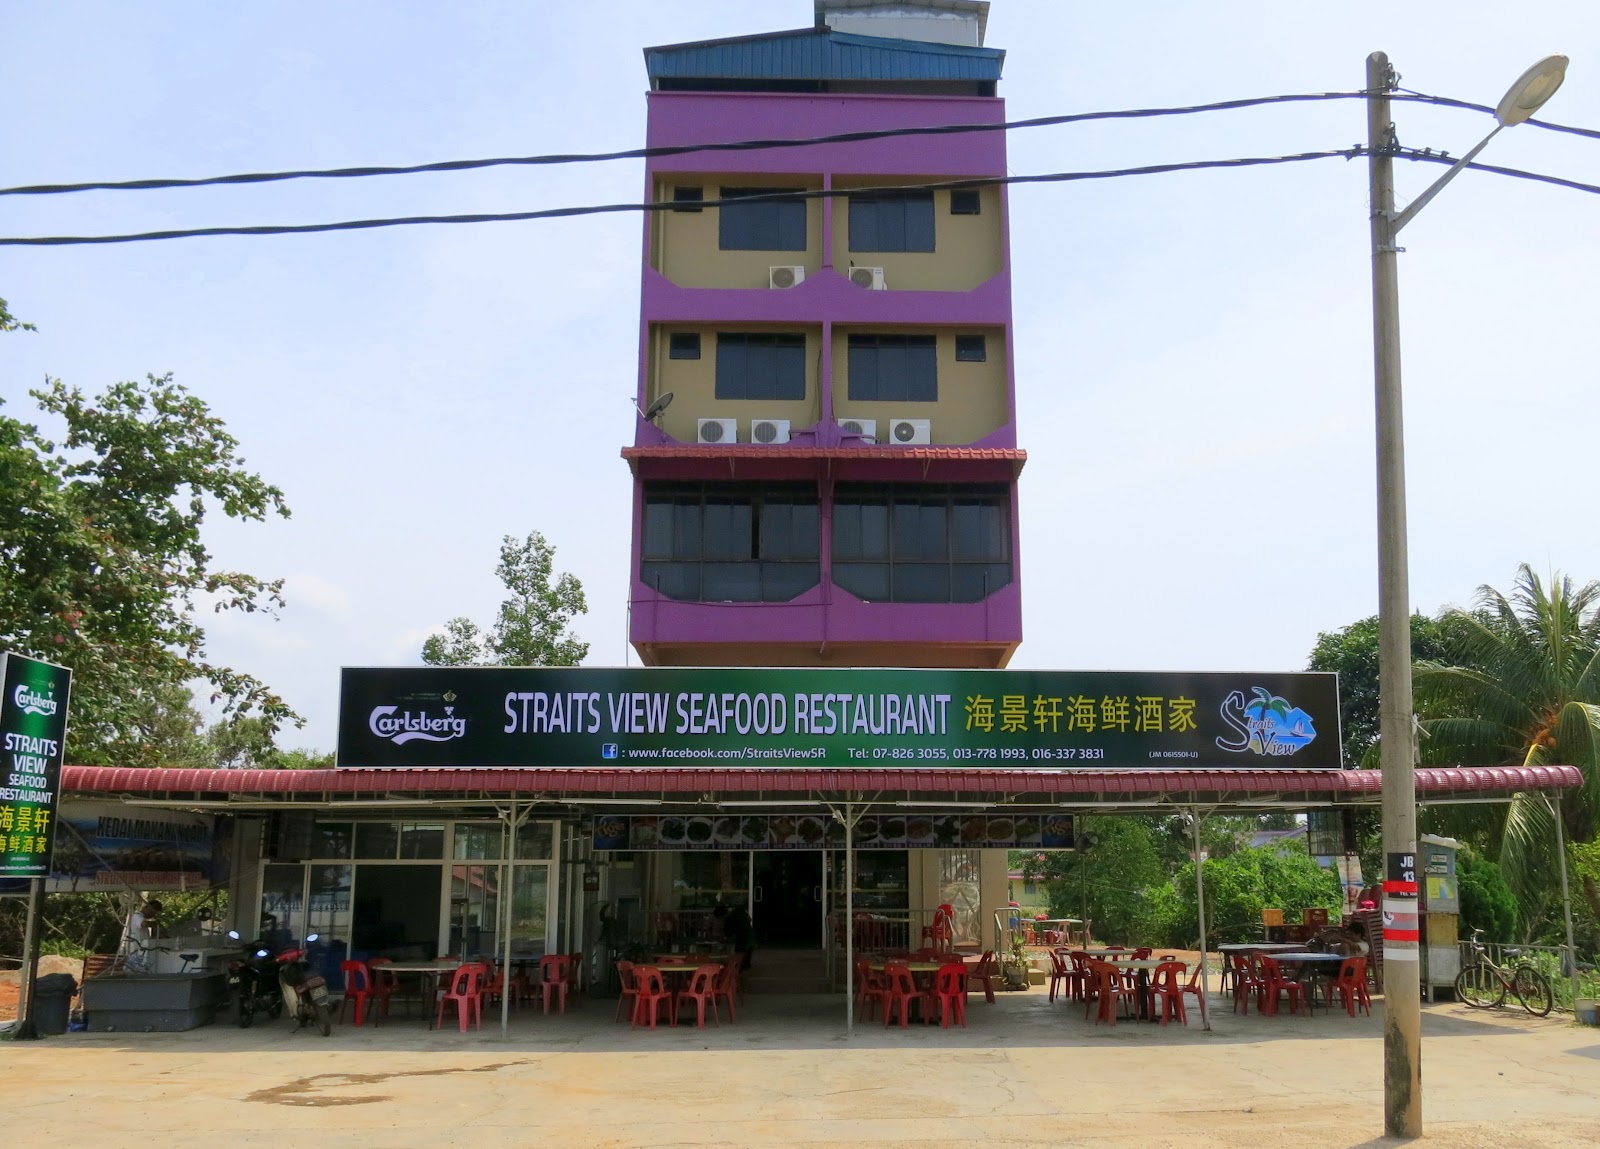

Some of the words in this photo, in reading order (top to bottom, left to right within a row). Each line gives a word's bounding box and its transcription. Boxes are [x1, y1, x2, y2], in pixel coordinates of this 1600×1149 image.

[15, 684, 58, 714] Carlsberg
[369, 705, 466, 740] Carlsberg
[504, 691, 601, 734] STRAITS
[608, 692, 670, 734] VIEW
[676, 692, 787, 735] SEAFOOD
[795, 693, 951, 736] RESTAURANT
[965, 694, 1198, 734] 海景轩海鲜酒家
[5, 732, 58, 757] STRAITS
[628, 747, 826, 759] www.facebook.com/StraitsViewSR
[848, 747, 869, 759] Tel:
[872, 748, 914, 759] 07-826
[917, 748, 949, 761] 3055,
[953, 748, 997, 759] 013-778
[1000, 748, 1028, 761] 1993,
[1032, 748, 1076, 759] 016-337
[1079, 748, 1104, 759] 3831
[1253, 729, 1296, 756] View
[13, 754, 48, 775] VIEW
[8, 773, 47, 789] SEAFOOD
[0, 787, 53, 804] RESTAURANT
[0, 805, 50, 834] 海景轩
[1400, 855, 1414, 868] JB
[1402, 870, 1415, 882] 13
